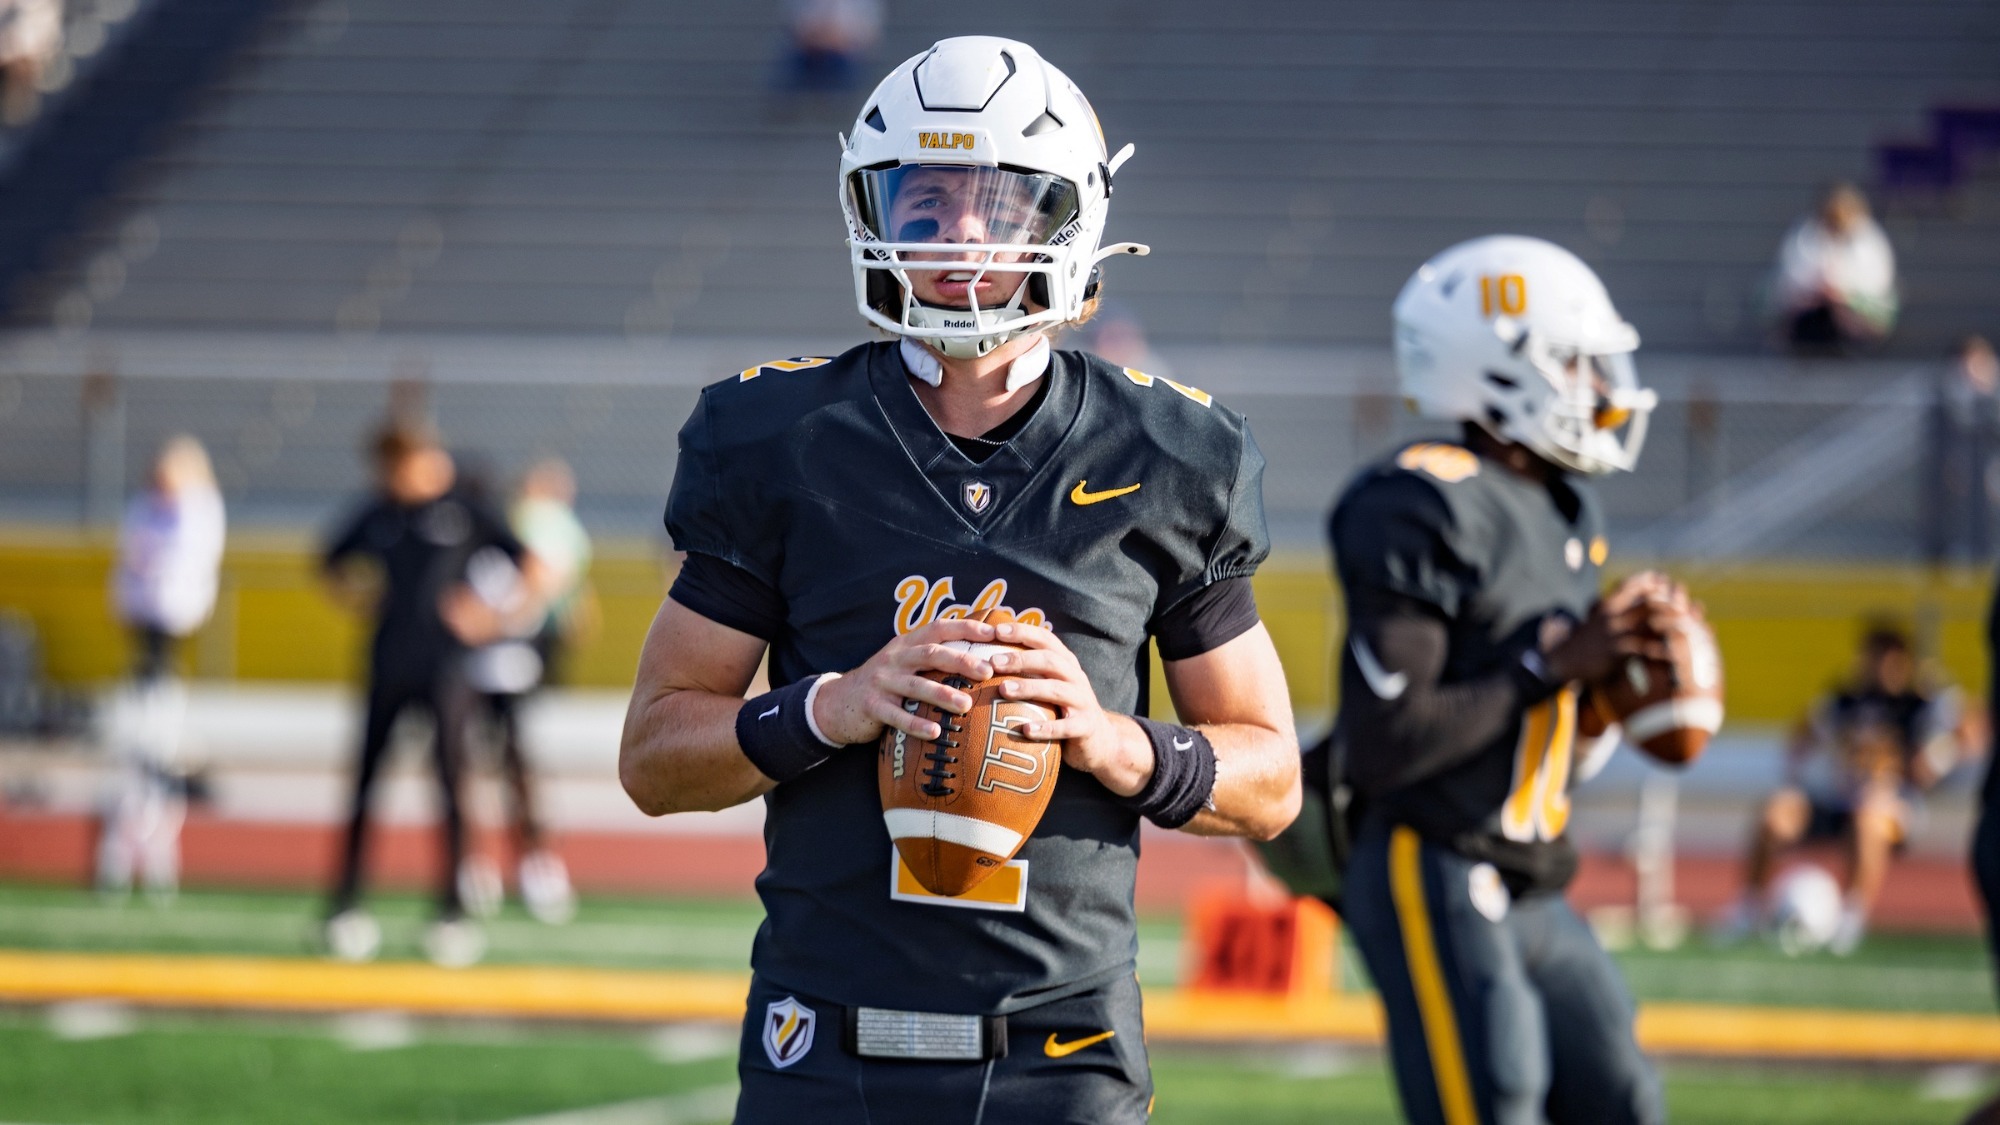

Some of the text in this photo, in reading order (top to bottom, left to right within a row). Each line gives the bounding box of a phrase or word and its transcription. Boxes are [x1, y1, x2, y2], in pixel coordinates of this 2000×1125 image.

[919, 132, 975, 150] VALPO
[1478, 273, 1529, 319] 10
[943, 319, 976, 328] Riddel
